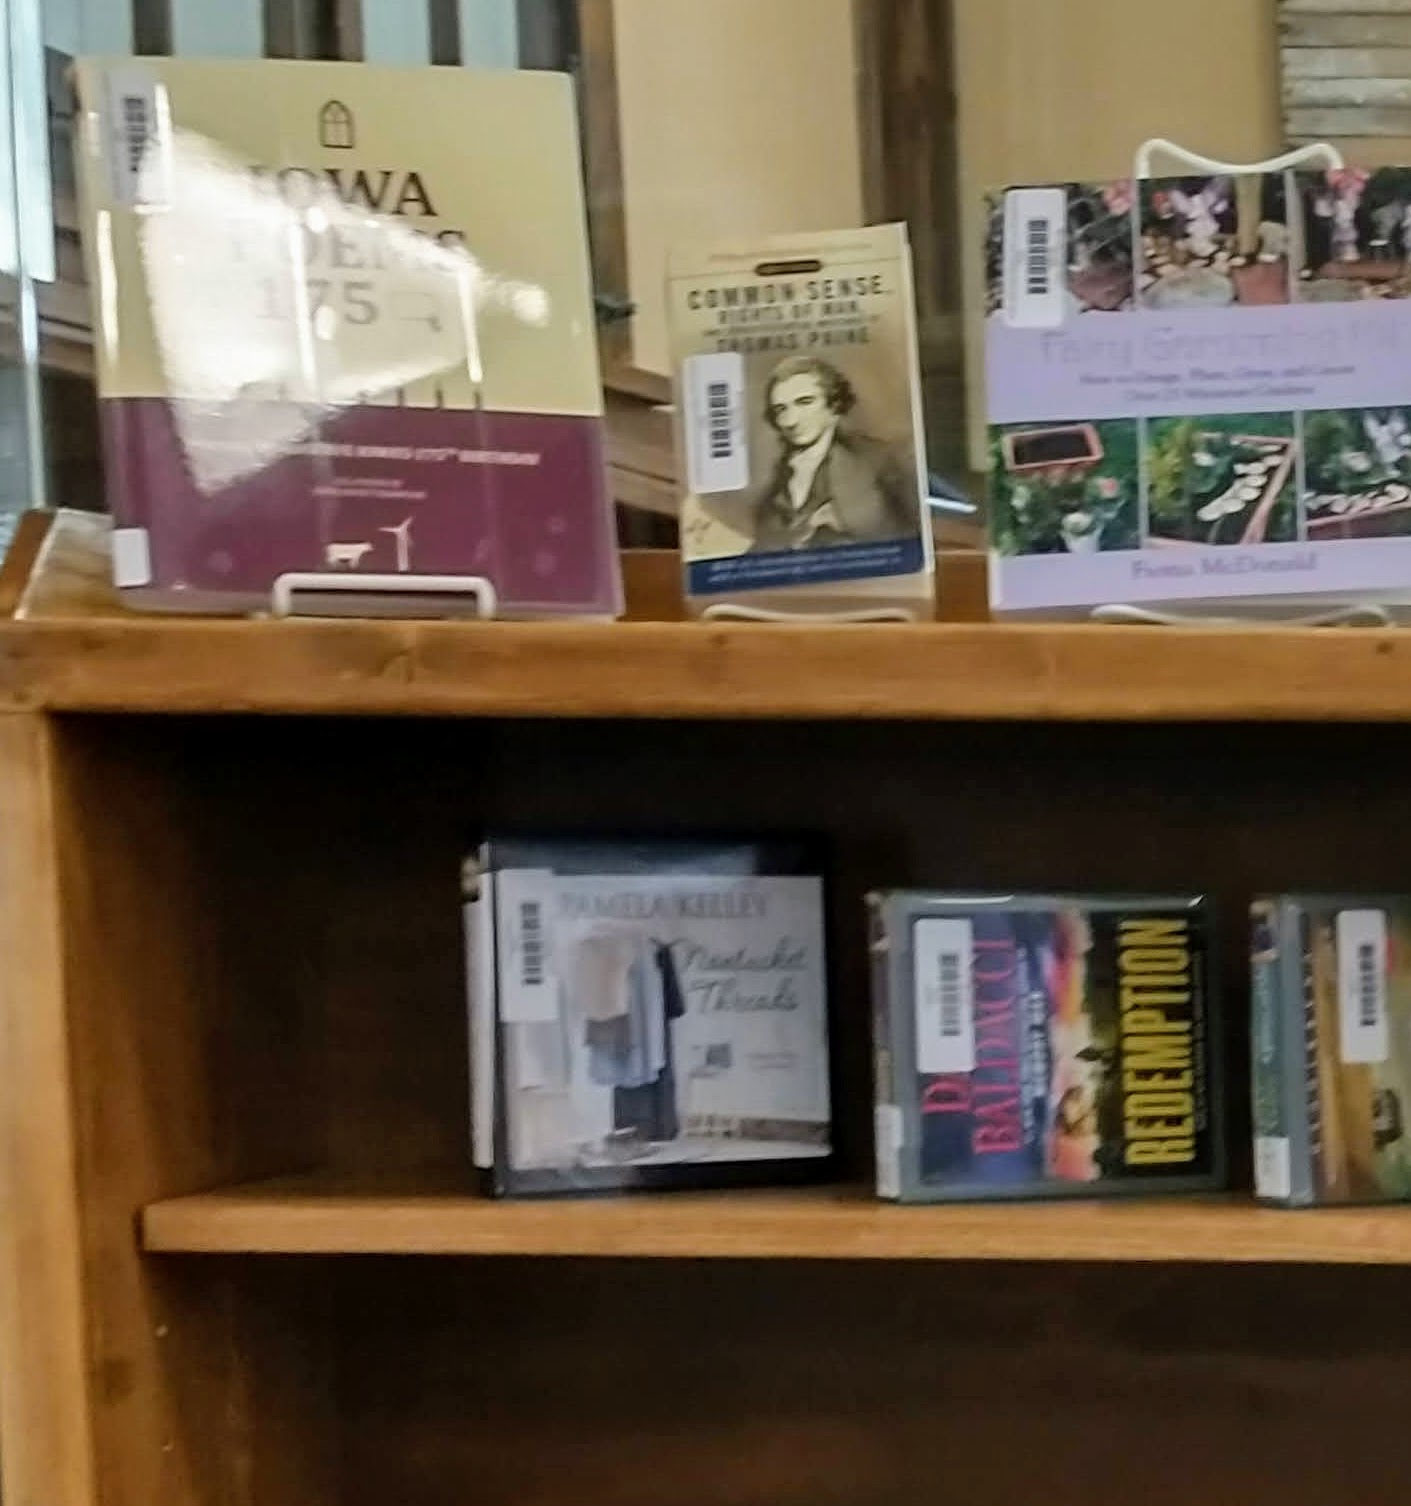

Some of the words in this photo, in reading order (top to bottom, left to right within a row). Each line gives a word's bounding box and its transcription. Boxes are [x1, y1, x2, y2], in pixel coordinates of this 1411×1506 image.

[687, 285, 794, 311] COMMON
[807, 274, 884, 301] SENSE
[1117, 918, 1197, 1166] REDEMPTION
